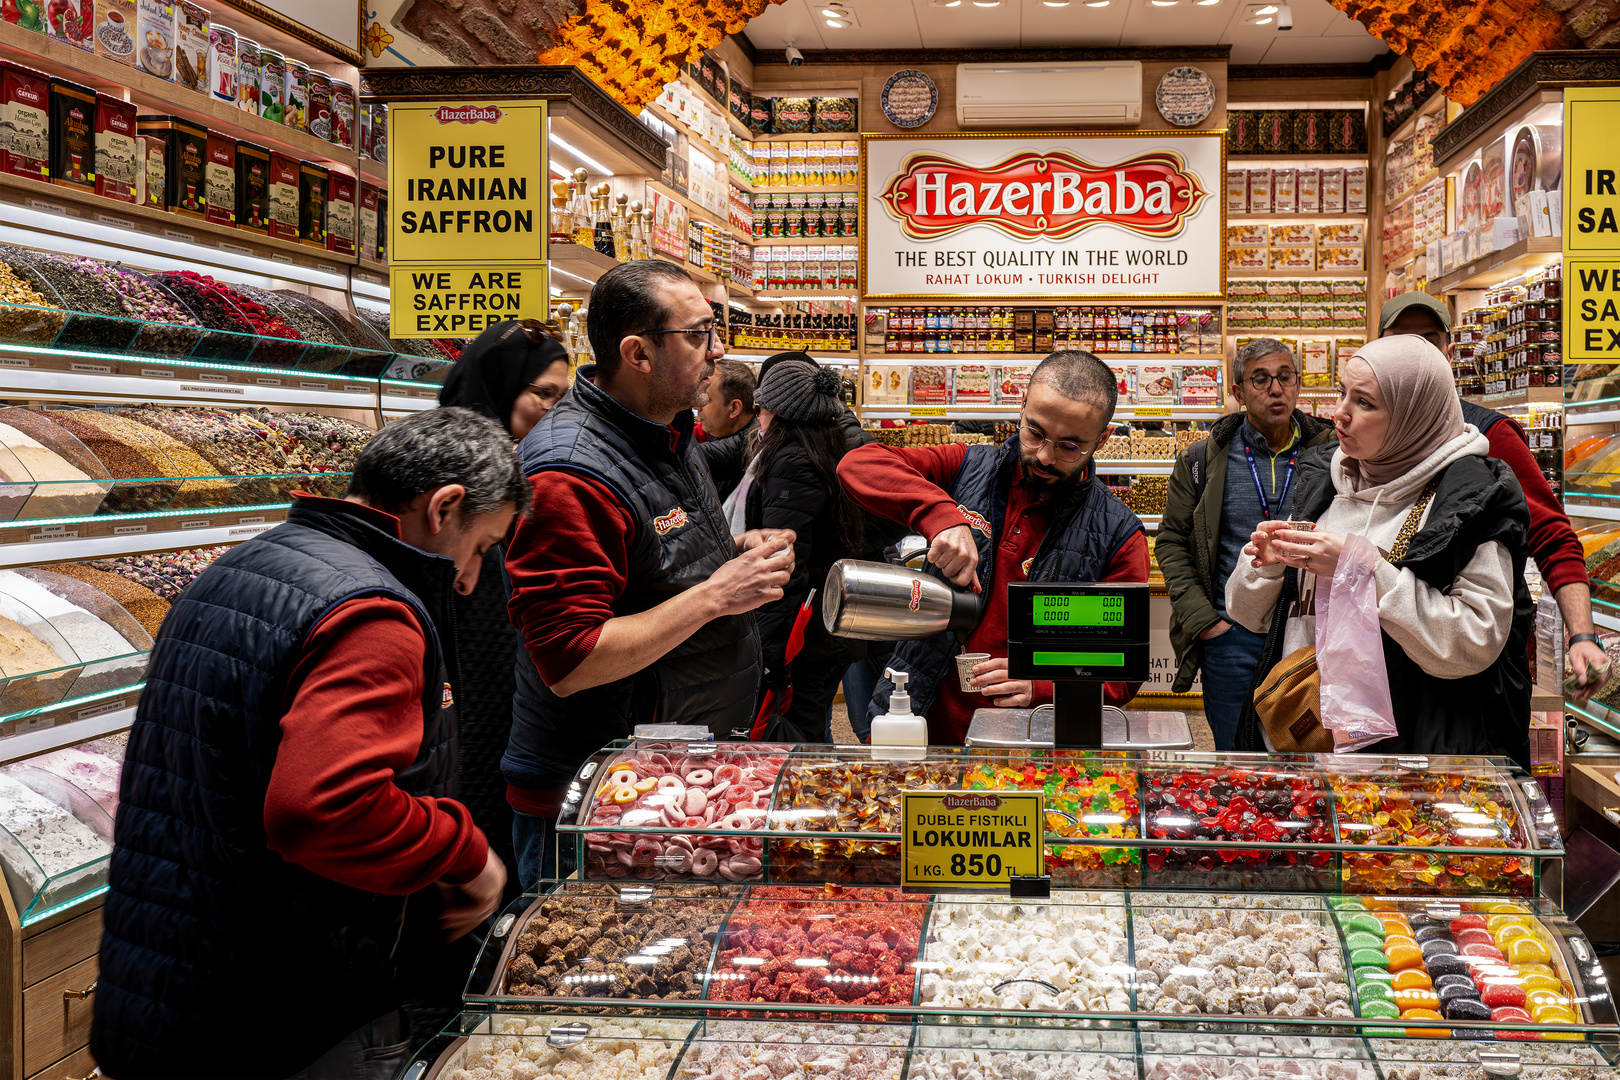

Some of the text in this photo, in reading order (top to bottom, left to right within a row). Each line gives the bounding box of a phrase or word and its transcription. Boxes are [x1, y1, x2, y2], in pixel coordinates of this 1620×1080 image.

[440, 108, 496, 121] HazerBaba
[430, 146, 505, 168] PURE
[408, 178, 526, 202] IRANIAN
[914, 170, 1173, 217] HazerBaba
[401, 210, 532, 234] SAFFRON
[895, 250, 1188, 268] THE BEST QUALITY IN THE WORLD
[412, 272, 522, 290] WE ARE
[926, 273, 1160, 285] RAHAT LOKUM TURKISH DELIGHT
[414, 293, 520, 310] SAFFRON
[1044, 597, 1122, 608] 0,000 0,00
[1044, 611, 1122, 622] 0,000 0,00
[948, 797, 996, 807] HazerBaba
[917, 814, 1027, 826] DUBLE FISTIKLI
[913, 830, 1031, 848] LOKUMLAR
[914, 865, 918, 876] 1
[924, 865, 944, 876] KG.
[951, 854, 1001, 877] 850
